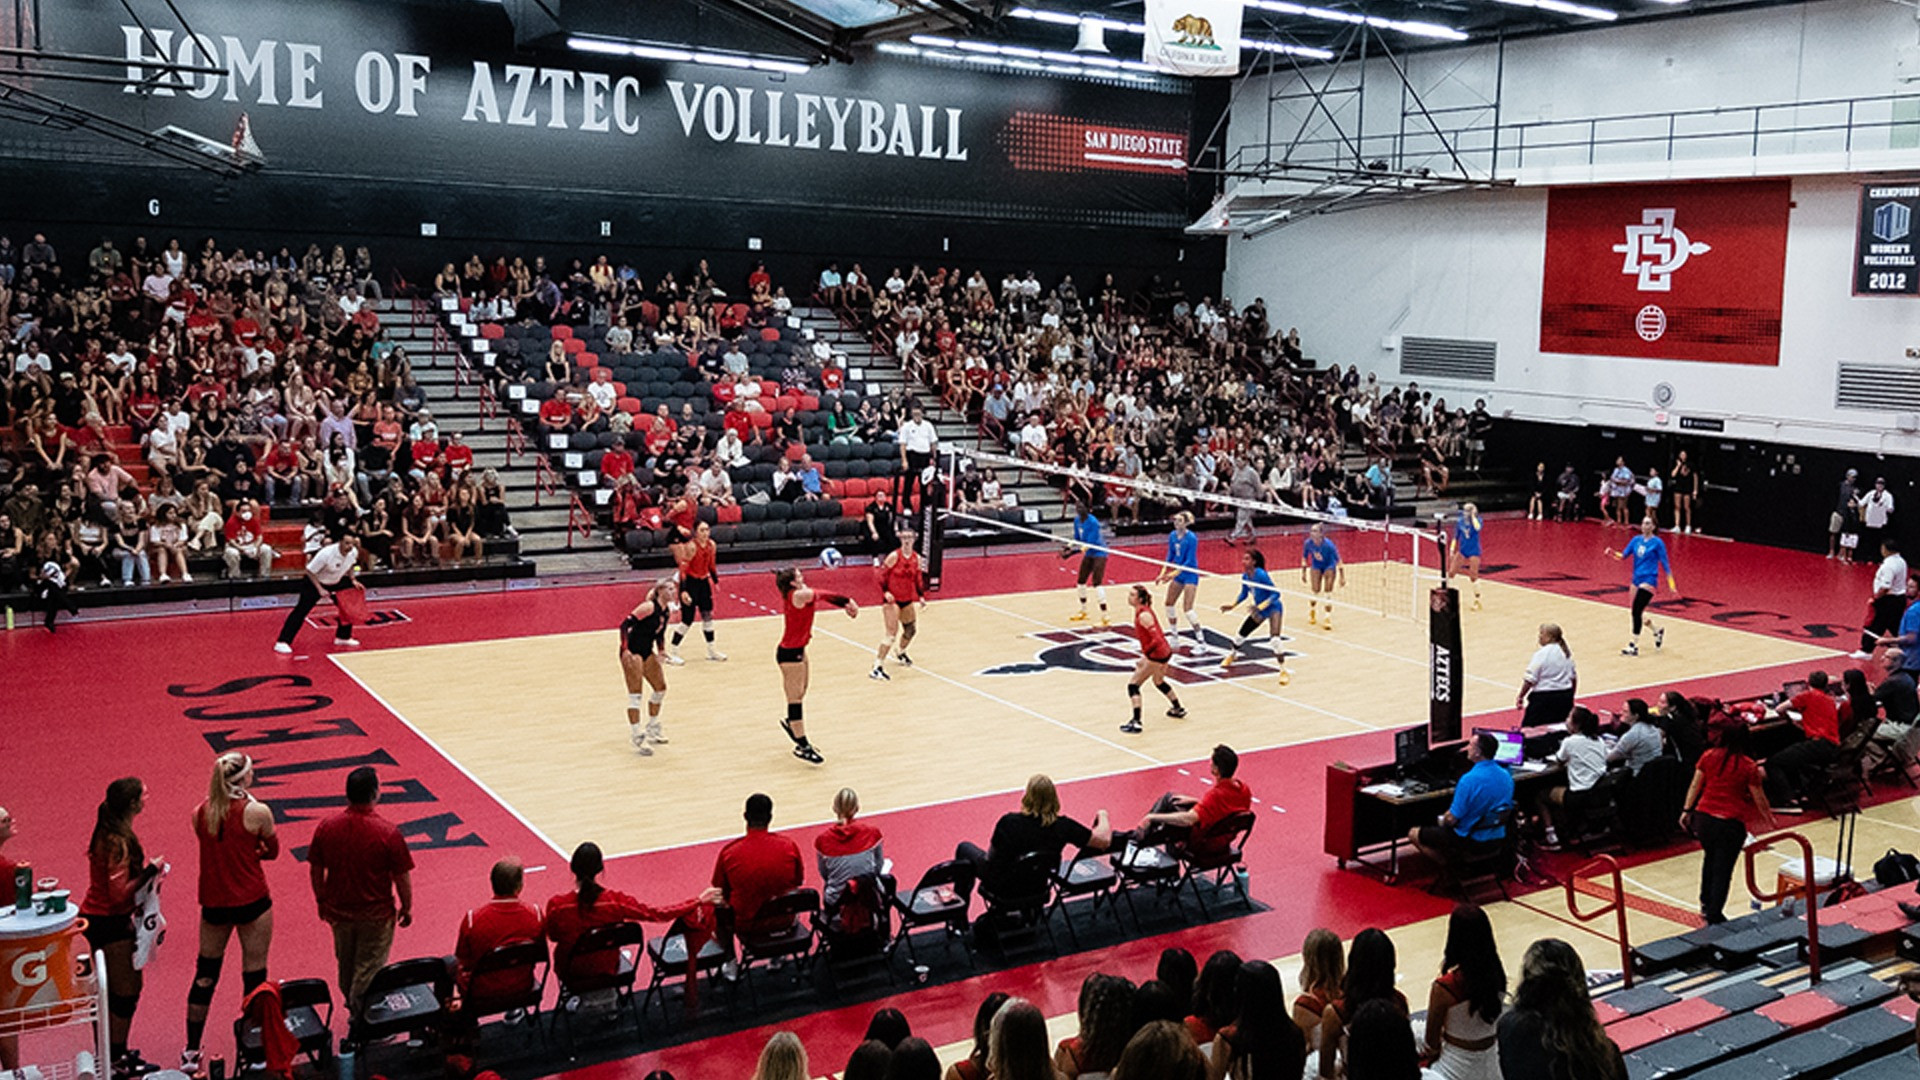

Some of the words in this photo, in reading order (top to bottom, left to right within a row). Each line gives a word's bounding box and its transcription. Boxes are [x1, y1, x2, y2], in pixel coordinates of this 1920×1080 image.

[120, 25, 323, 108] HOME
[355, 51, 431, 117] OF
[461, 61, 640, 135] AZTEC
[665, 80, 968, 161] VOLLEYBALL
[1084, 130, 1108, 148] SAN
[1110, 133, 1147, 153] DIEGO
[1148, 137, 1182, 155] STATE
[148, 198, 160, 216] G
[601, 221, 611, 236] H
[1870, 244, 1911, 254] WOMEN'S
[1863, 255, 1916, 265] VOLLEYBALL
[1869, 273, 1907, 289] 2012
[1435, 645, 1451, 702] AZTECS
[167, 674, 489, 863] AZTECS
[144, 913, 158, 931] G
[11, 950, 48, 986] G
